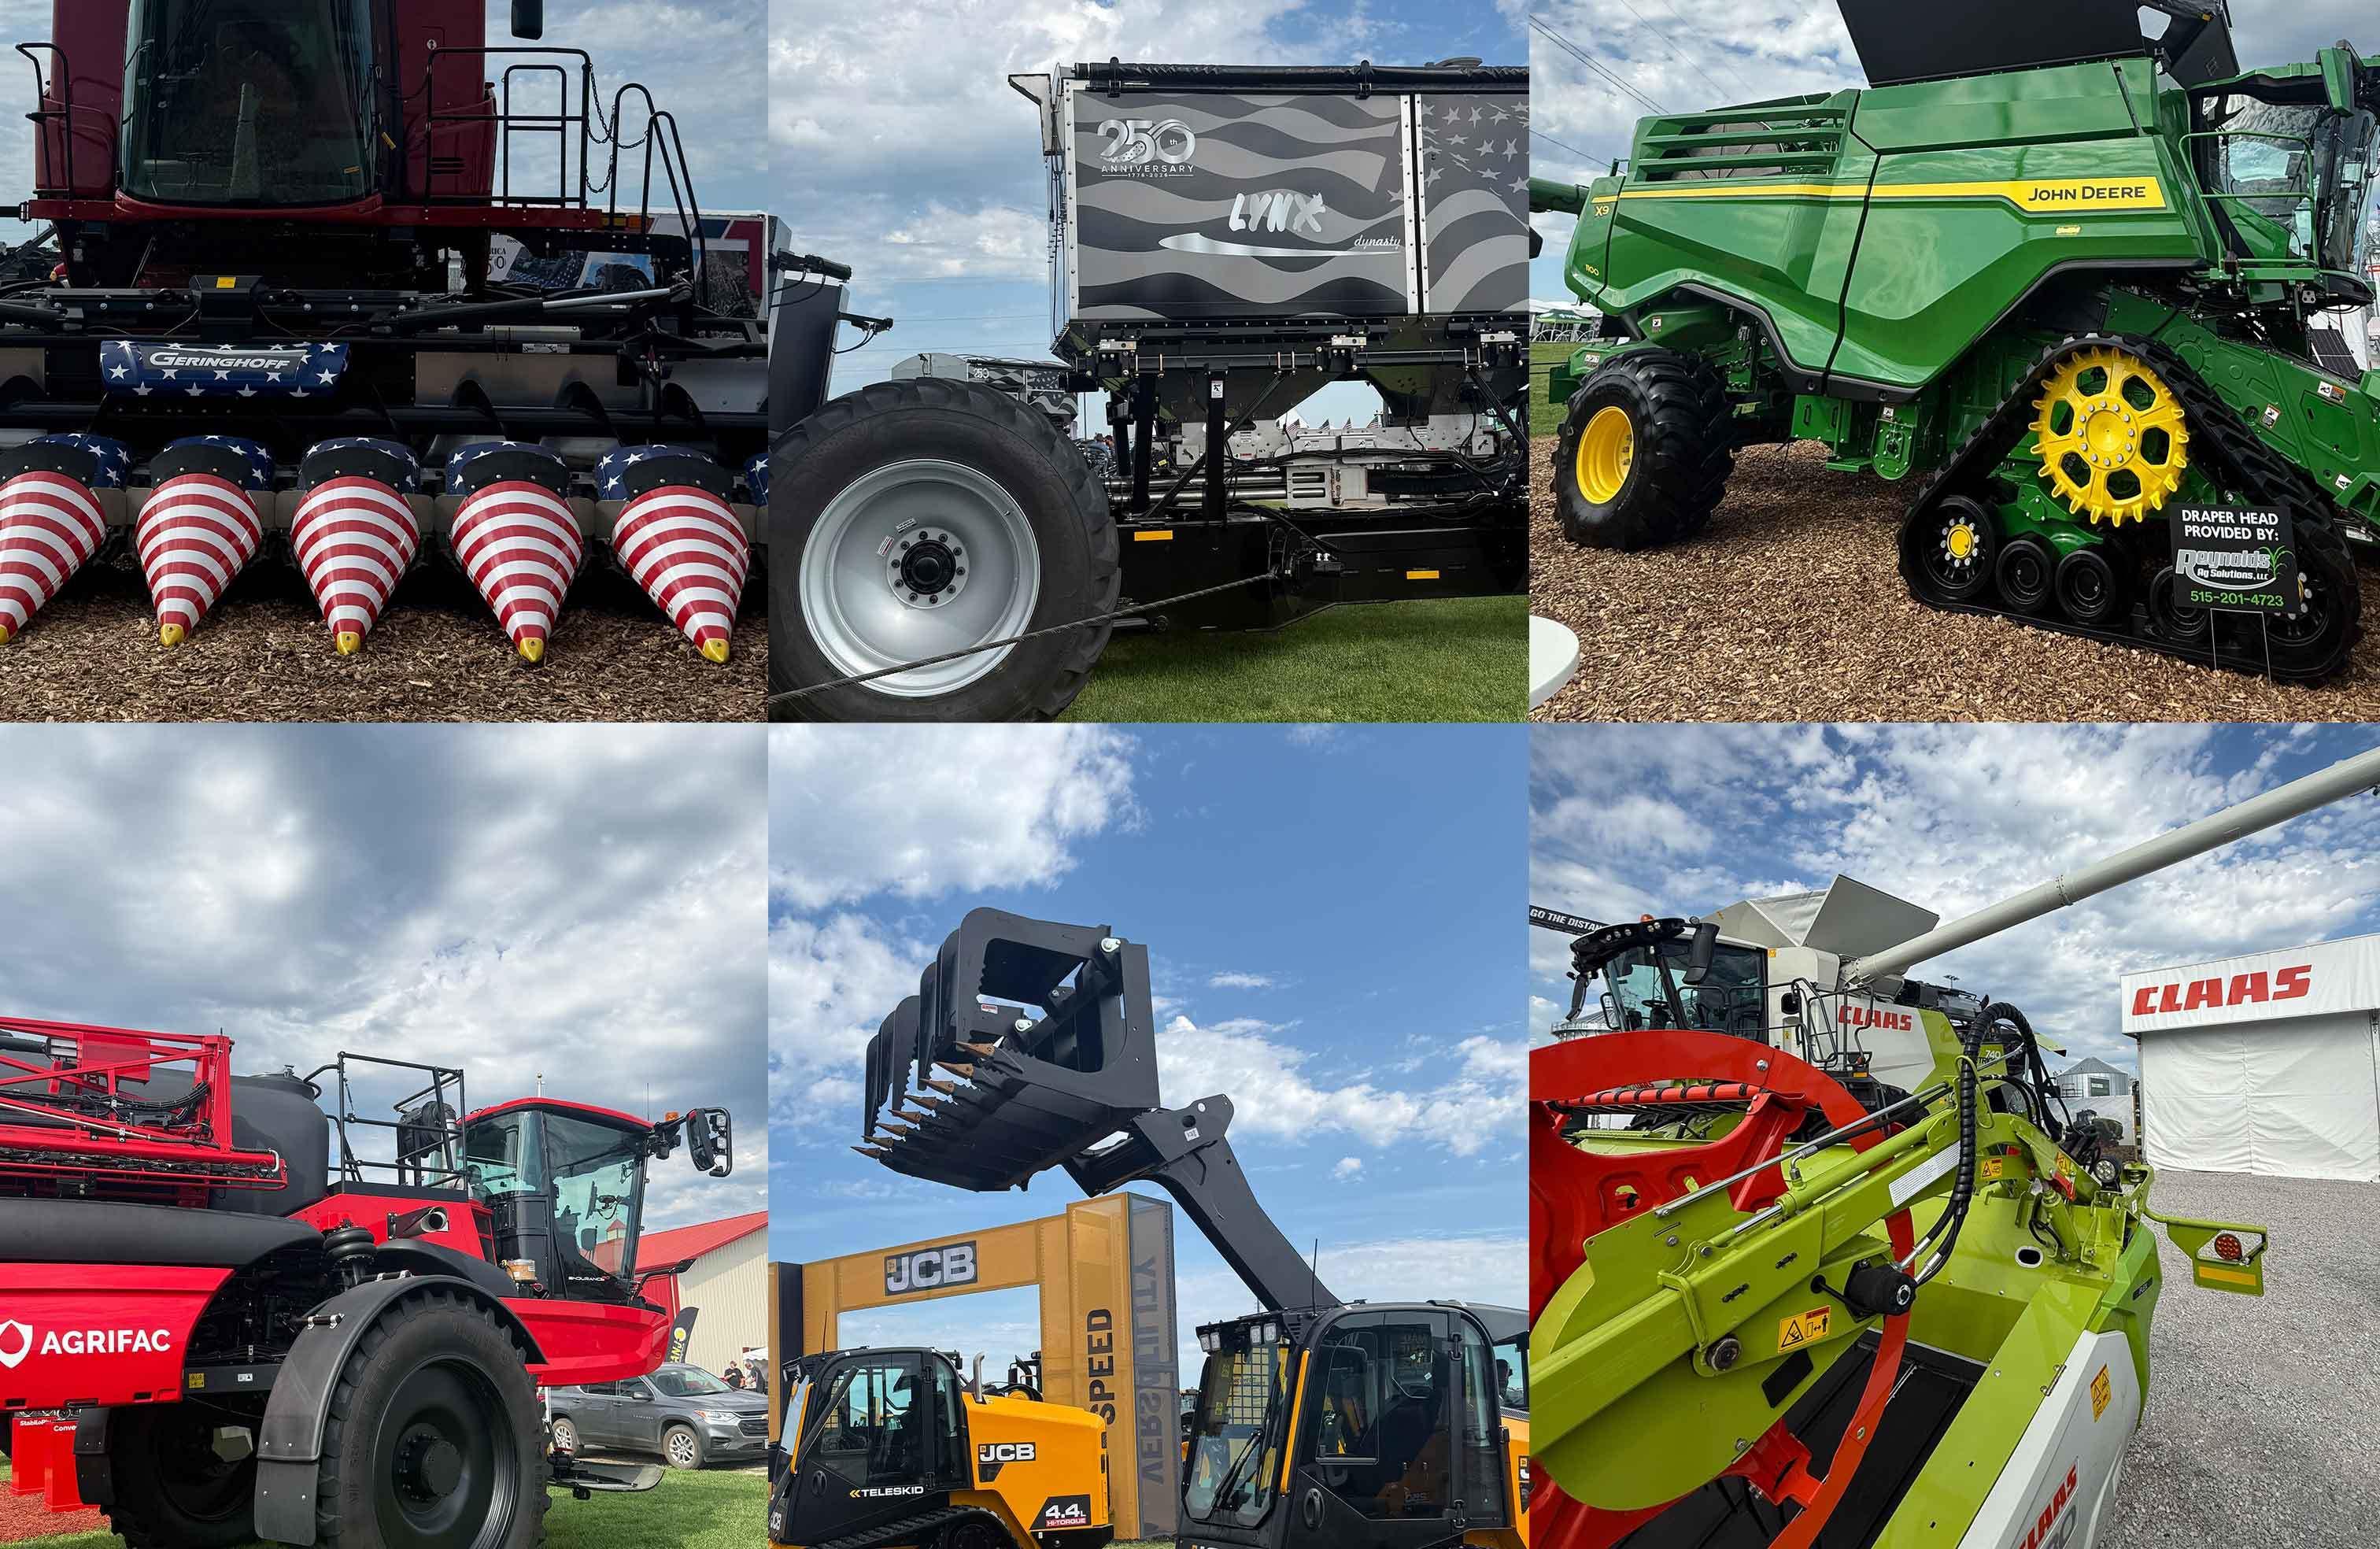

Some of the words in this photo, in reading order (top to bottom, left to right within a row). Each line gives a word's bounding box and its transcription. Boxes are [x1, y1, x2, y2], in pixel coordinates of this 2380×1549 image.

[1097, 119, 1196, 164] 250
[2028, 187, 2077, 201] JOHN
[2082, 186, 2145, 200] DEERE
[1229, 193, 1326, 233] LYNX
[1595, 205, 1610, 216] X9
[1354, 235, 1401, 250] dynasty
[1585, 264, 1599, 276] 1100
[150, 352, 290, 370] GERINGHOFF
[2182, 509, 2235, 524] DRAPER
[2240, 512, 2279, 526] HEAD
[2184, 525, 2252, 540] PROVIDED
[2256, 528, 2279, 542] BY:
[2175, 549, 2271, 574] Reynolds
[2197, 567, 2209, 578] Ag
[2210, 568, 2256, 580] Solutions,
[2190, 590, 2284, 607] 515-201-4723
[1529, 908, 1546, 919] GO
[1547, 912, 1567, 924] THE
[1567, 918, 1602, 931] DISTAN
[2132, 964, 2312, 1016] CLAAS
[1838, 1004, 1913, 1031] CLAAS
[1985, 1050, 2001, 1059] 740
[886, 1245, 975, 1292] JCB
[40, 1329, 171, 1355] AGRIFAC
[1086, 1308, 1116, 1425] SPEED
[979, 1444, 1035, 1462] JCB
[861, 1486, 924, 1497] TELESKID
[2019, 1462, 2077, 1549] LAAS
[1046, 1518, 1086, 1527] HI-TORQUE
